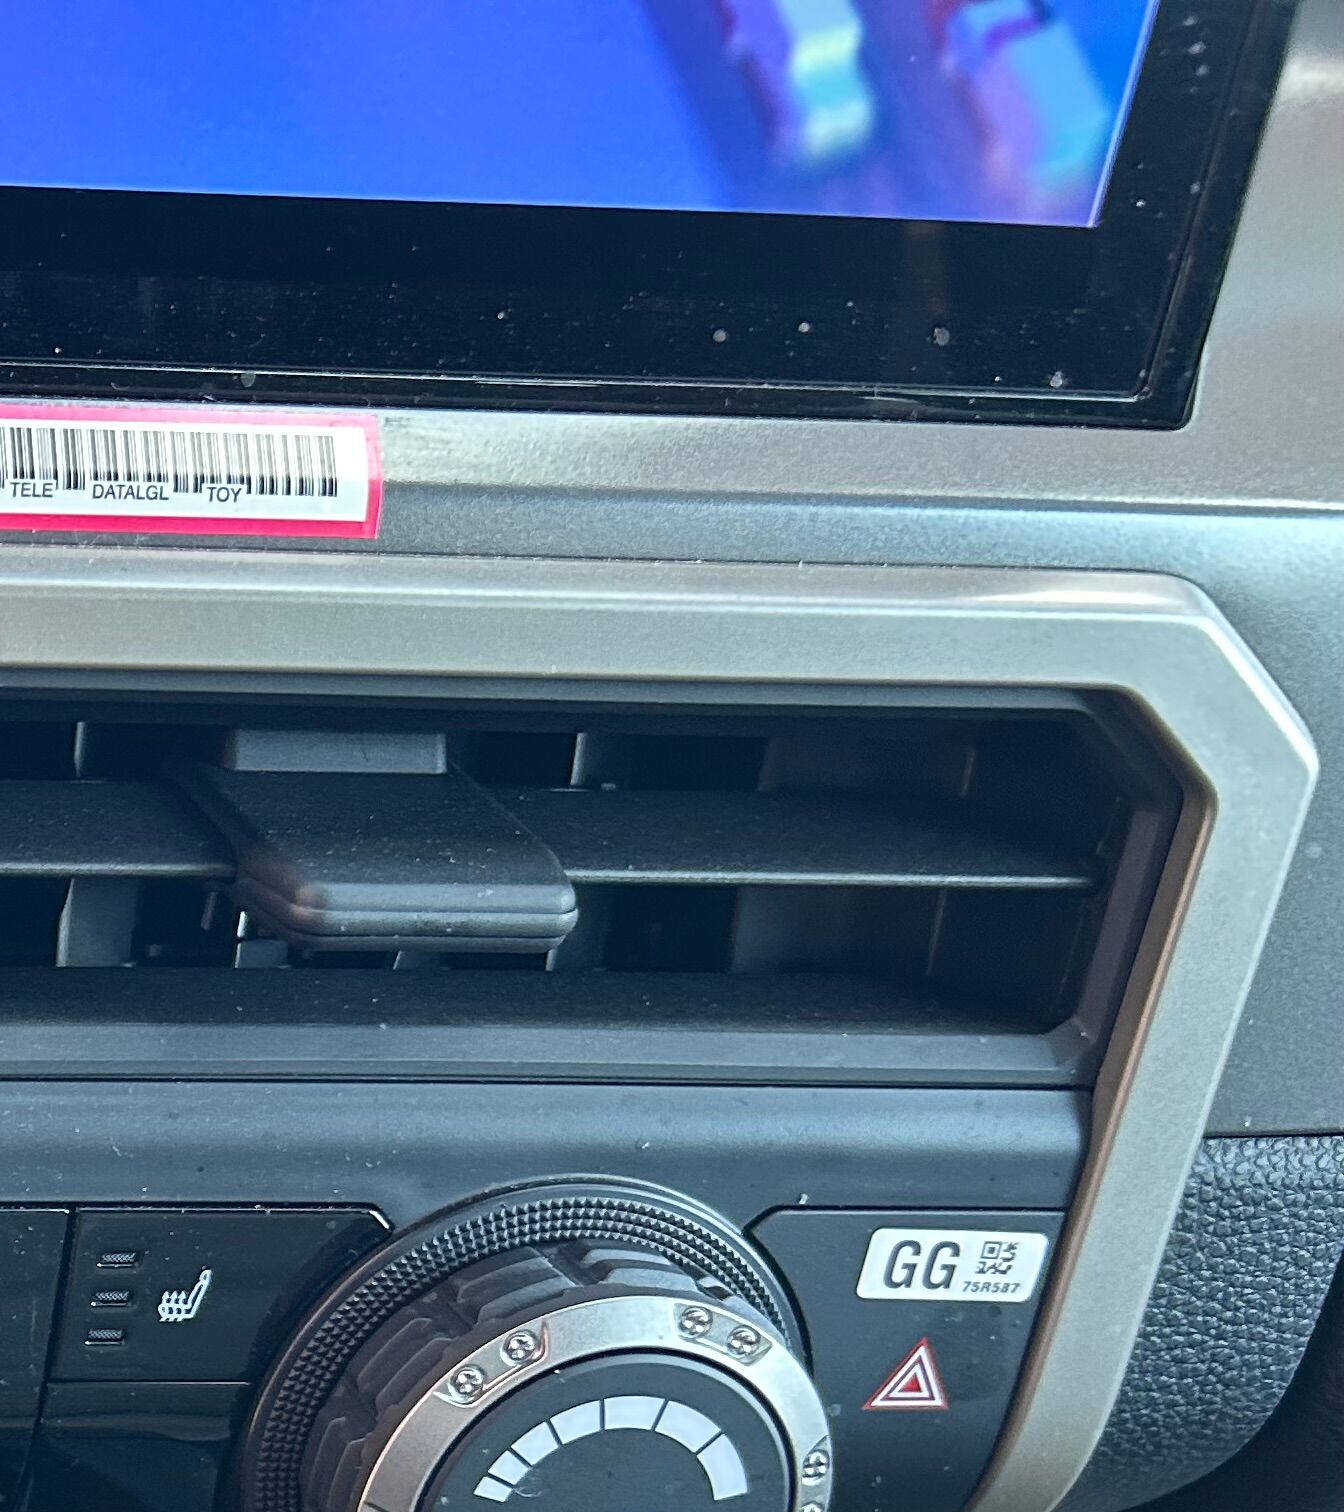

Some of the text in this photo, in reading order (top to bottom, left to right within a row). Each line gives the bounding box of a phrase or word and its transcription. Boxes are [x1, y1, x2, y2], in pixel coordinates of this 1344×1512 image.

[10, 481, 242, 504] TELE DATALGL TOY
[883, 1240, 961, 1290] GG
